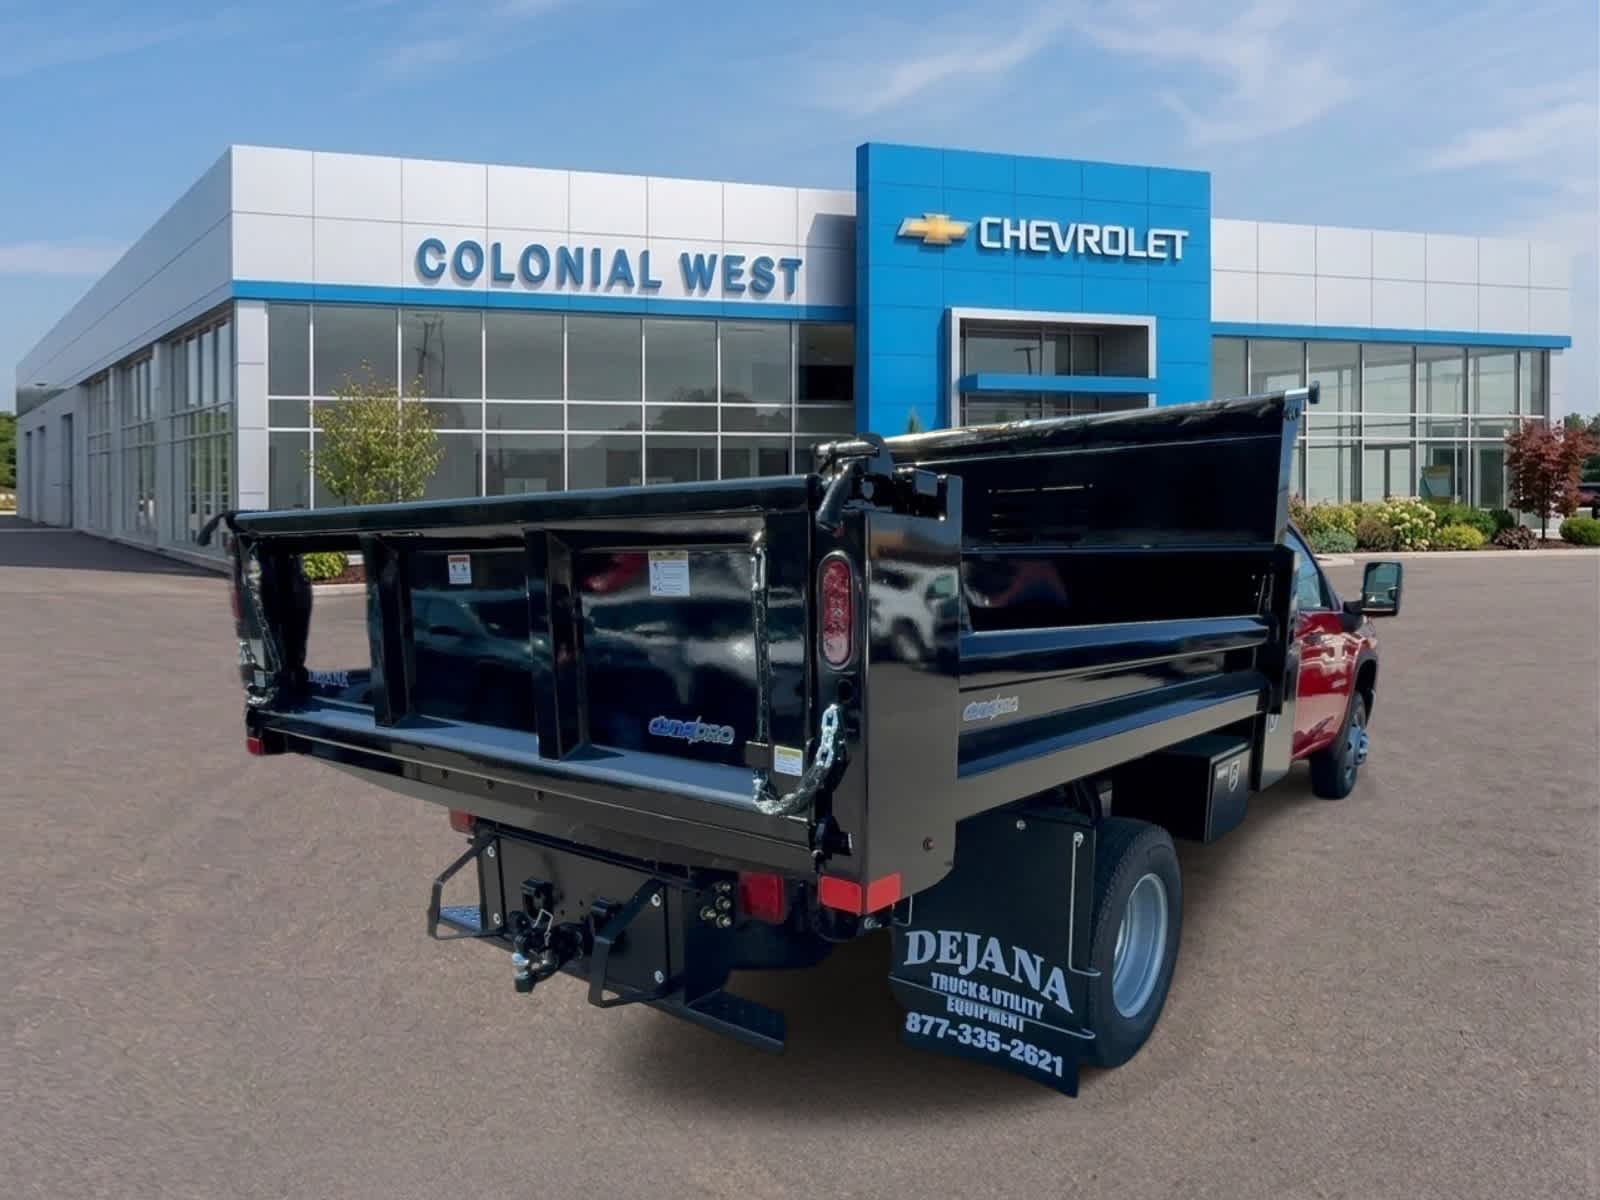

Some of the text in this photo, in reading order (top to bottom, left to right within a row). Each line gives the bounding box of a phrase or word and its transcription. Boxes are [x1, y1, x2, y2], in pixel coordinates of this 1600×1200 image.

[416, 238, 803, 296] COLONIAL WEST
[980, 217, 1189, 260] CHEVROLET
[903, 930, 1073, 1014] DEJANA
[946, 997, 1024, 1032] EQUIPMENT
[905, 1011, 1063, 1078] 877-335-2621
